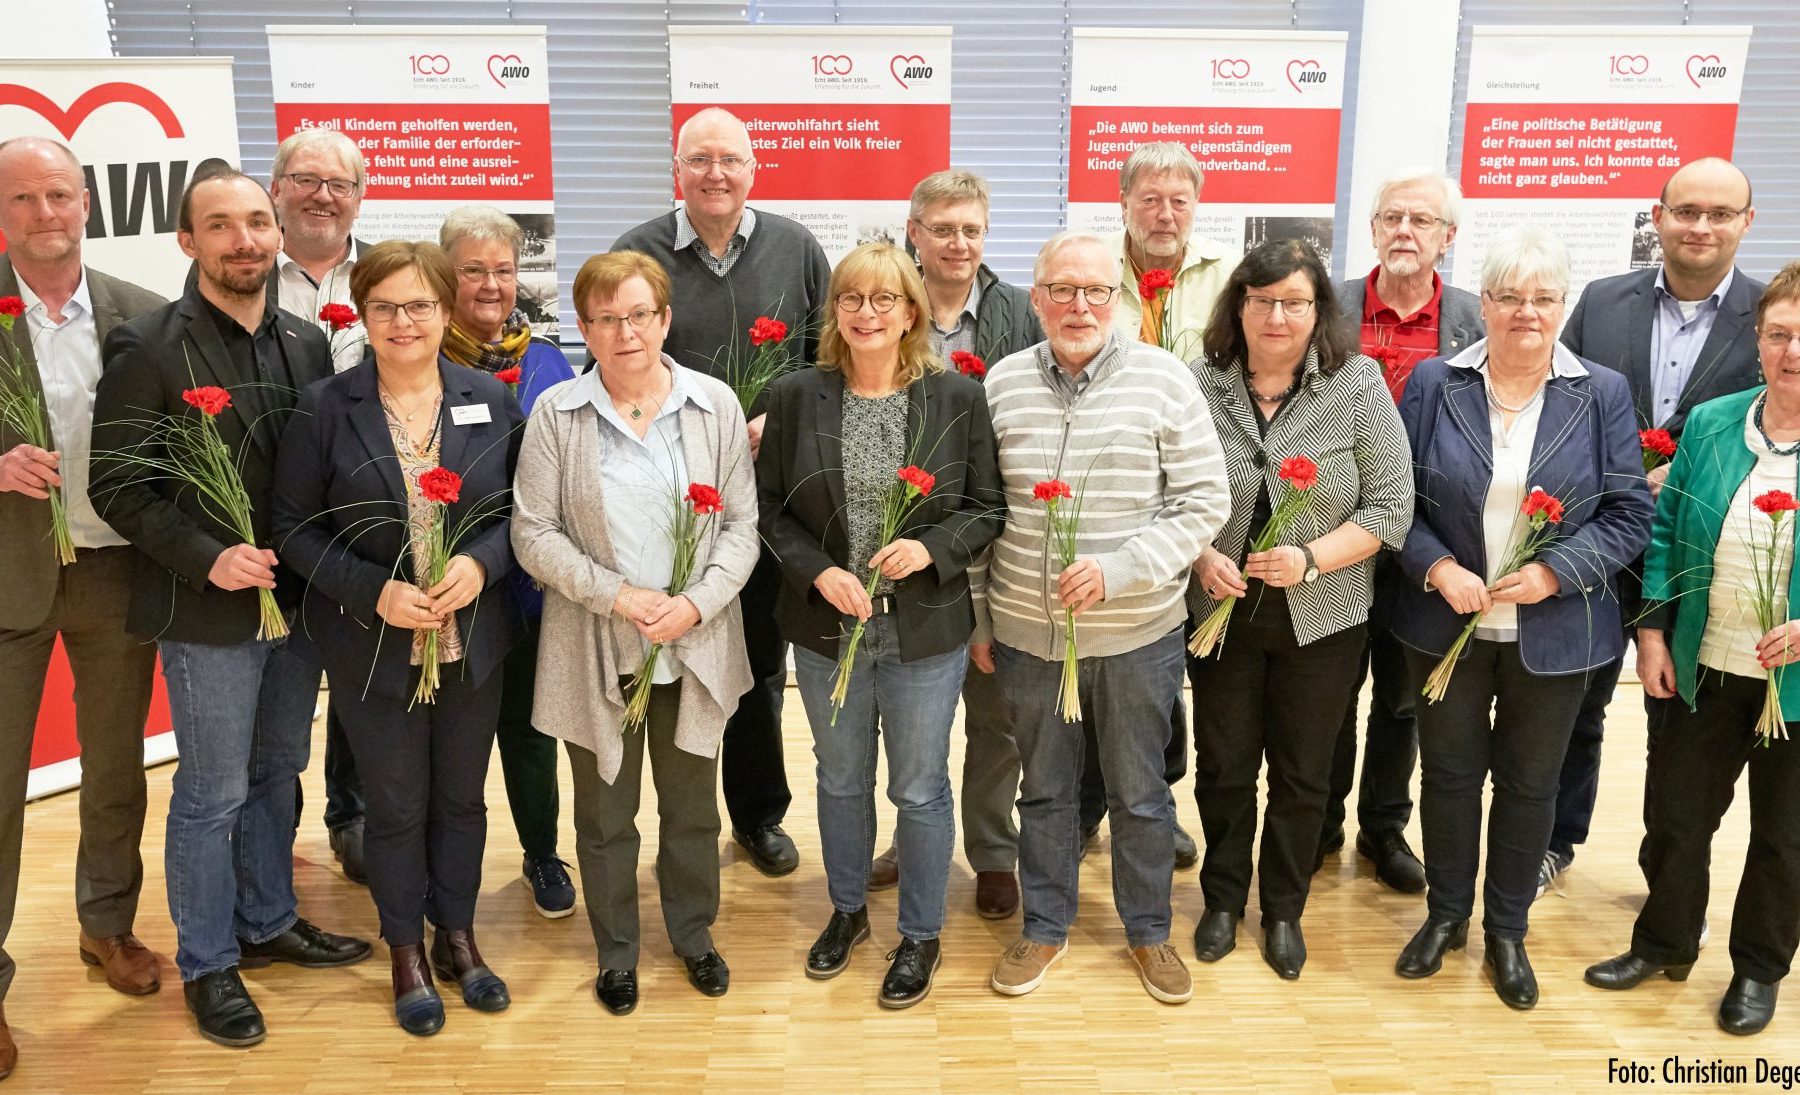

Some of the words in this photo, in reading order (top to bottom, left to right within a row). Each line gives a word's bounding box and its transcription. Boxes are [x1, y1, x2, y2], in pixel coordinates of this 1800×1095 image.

[409, 55, 450, 75] 100
[812, 55, 853, 75] 100
[1210, 58, 1250, 79] 100
[1609, 55, 1649, 75] 100
[501, 66, 530, 79] AWO
[903, 66, 933, 79] AWO
[1298, 71, 1327, 83] AWO
[1698, 66, 1727, 78] AWO
[290, 81, 315, 89] Kinder
[689, 81, 719, 89] Freiheit
[1089, 84, 1117, 93] Jugend
[1486, 81, 1540, 90] Gleichstellung
[318, 118, 341, 131] soll
[345, 118, 396, 131] Kindern
[401, 118, 459, 133] geholfen
[463, 119, 517, 133] werden,
[744, 119, 843, 131] eiterwohlfahrt
[846, 119, 880, 131] sieht
[1120, 121, 1148, 133] AWO
[1152, 122, 1205, 134] bekennt
[1208, 122, 1232, 134] sich
[1236, 125, 1264, 134] zum
[1523, 117, 1586, 133] politische
[1590, 117, 1663, 133] Betätigung
[357, 137, 380, 149] der
[383, 136, 430, 149] Familie
[434, 137, 457, 149] der
[460, 136, 521, 149] erforder-
[781, 137, 804, 149] Ziel
[809, 137, 830, 149] ein
[833, 137, 861, 149] Volk
[865, 137, 902, 149] freier
[1190, 139, 1292, 155] eigenständigem
[1482, 136, 1504, 148] der
[1507, 136, 1551, 148] Frauen
[1555, 135, 1574, 148] sei
[1577, 136, 1611, 148] nicht
[1615, 137, 1678, 151] gestattet,
[374, 155, 406, 167] fehlt
[410, 155, 435, 167] und
[439, 155, 468, 167] eine
[472, 155, 519, 167] ausrei-
[1087, 157, 1124, 170] Kinde
[1198, 159, 1271, 171] ndverband.
[1480, 155, 1515, 169] sagte
[1519, 156, 1547, 167] man
[1552, 156, 1580, 167] uns.
[1584, 154, 1603, 167] Ich
[1607, 154, 1653, 167] konnte
[1657, 154, 1680, 167] das
[365, 173, 411, 188] iehung
[414, 173, 447, 185] nicht
[450, 173, 486, 185] zuteil
[1478, 172, 1512, 184] nicht
[1515, 174, 1547, 187] ganz
